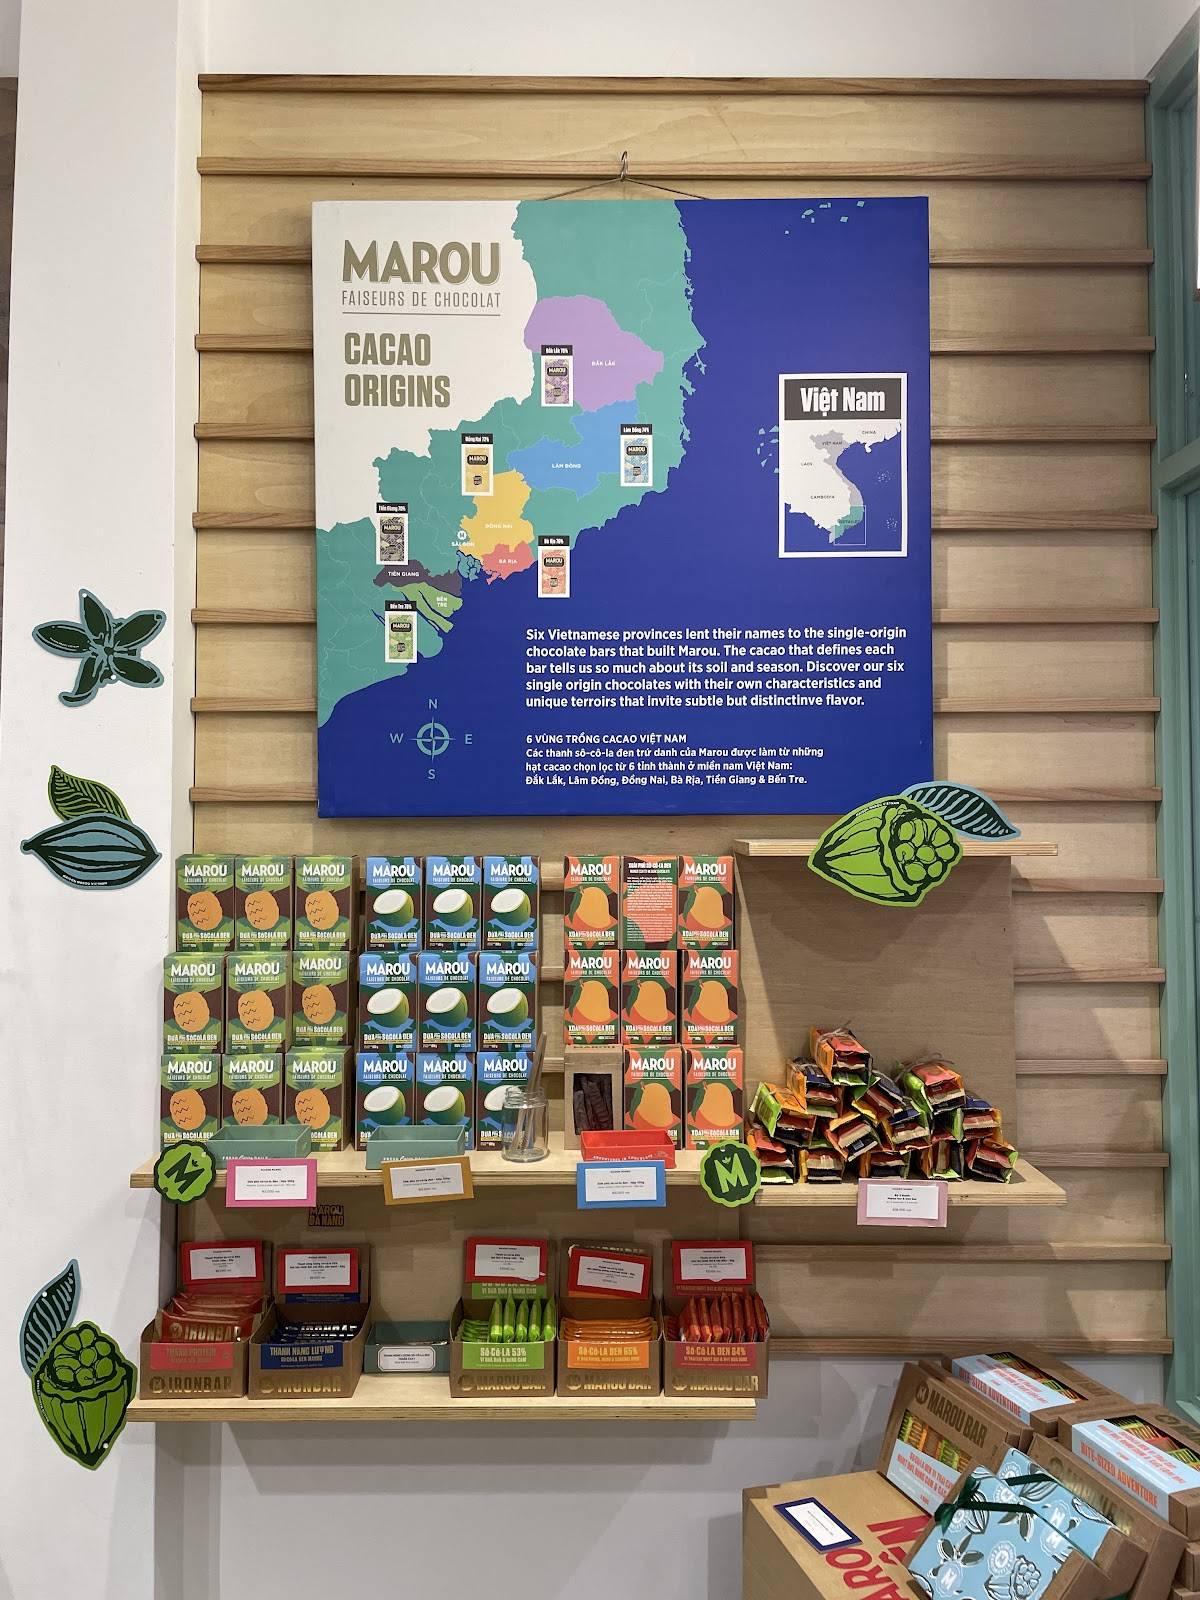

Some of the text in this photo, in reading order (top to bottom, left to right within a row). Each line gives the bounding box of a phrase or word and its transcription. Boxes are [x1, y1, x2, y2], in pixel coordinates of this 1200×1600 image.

[342, 239, 501, 286] MAROU
[342, 290, 501, 308] FAISEURS DE CHOCOLAT
[344, 332, 431, 366] CACAO
[344, 373, 451, 408] ORIGINS
[800, 387, 886, 417] Việt Nam
[526, 626, 906, 642] Six Vietnamese provinces lent their names to the single-origin
[526, 643, 894, 657] chocolate bars that built Marou. The cacao that defines each
[526, 660, 904, 674] bar tells us so much about its soil and season. Discover our six
[526, 677, 882, 692] single origin chocolates with their own characteristics and
[428, 698, 438, 709] N
[526, 693, 864, 709] unique terroirs that invite subtle but distinctinve flavor.
[389, 732, 404, 744] W
[464, 733, 473, 745] E
[526, 735, 532, 743] 6
[535, 733, 563, 744] VÙNG
[602, 735, 638, 743] CACAO
[640, 732, 662, 745] VIỆT
[664, 734, 686, 743] NAM
[526, 748, 544, 757] Các
[546, 748, 573, 757] thanh
[574, 748, 614, 758] sô-cô-la
[616, 748, 634, 757] đen
[636, 747, 652, 757] trứ
[654, 748, 678, 757] danh
[680, 746, 696, 757] của
[698, 748, 728, 757] Marou
[759, 747, 776, 756] làm
[778, 747, 790, 756] từ
[427, 768, 436, 780] S
[526, 762, 541, 773] hạt
[573, 762, 596, 773] chọn
[598, 762, 613, 773] lọc
[615, 762, 627, 771] từ
[628, 762, 635, 771] 6
[658, 761, 686, 771] thành
[746, 761, 766, 772] Việt
[768, 761, 792, 770] Nam:
[568, 775, 588, 785] Lâm
[650, 775, 668, 786] Nai,
[670, 775, 683, 784] Bà
[728, 775, 757, 785] Giang
[758, 775, 766, 784] &
[789, 774, 808, 784] Tre.
[184, 864, 228, 878] MAROU
[241, 864, 284, 878] MAROU
[302, 864, 344, 877] MAROU
[372, 864, 415, 877] MAROU
[432, 864, 474, 877] MAROU
[490, 863, 532, 876] MAROU
[570, 863, 612, 876] MAROU
[684, 863, 727, 875] MAROU
[234, 962, 280, 977] MAROU
[300, 958, 342, 972] MAROU
[366, 962, 411, 976] MAROU
[425, 962, 469, 975] MAROU
[486, 962, 530, 975] MAROU
[570, 957, 612, 970] MAROU
[628, 957, 670, 970] MAROU
[690, 956, 732, 970] MAROU
[170, 963, 216, 978] MAROU
[168, 1060, 212, 1074] MAROU
[229, 1060, 274, 1074] MAROU
[292, 1060, 337, 1074] MAROU
[363, 1060, 408, 1073] MAROU
[423, 1060, 467, 1073] MAROU
[484, 1058, 528, 1072] MAROU
[631, 1058, 674, 1071] MAROU
[693, 1058, 736, 1071] MAROU
[713, 1153, 749, 1194] M
[168, 1376, 232, 1393] IRONBAR
[988, 1386, 1022, 1417] ADVENTURE
[926, 1390, 988, 1448] MAROU BAR
[1117, 1470, 1158, 1509] ADVENTURE
